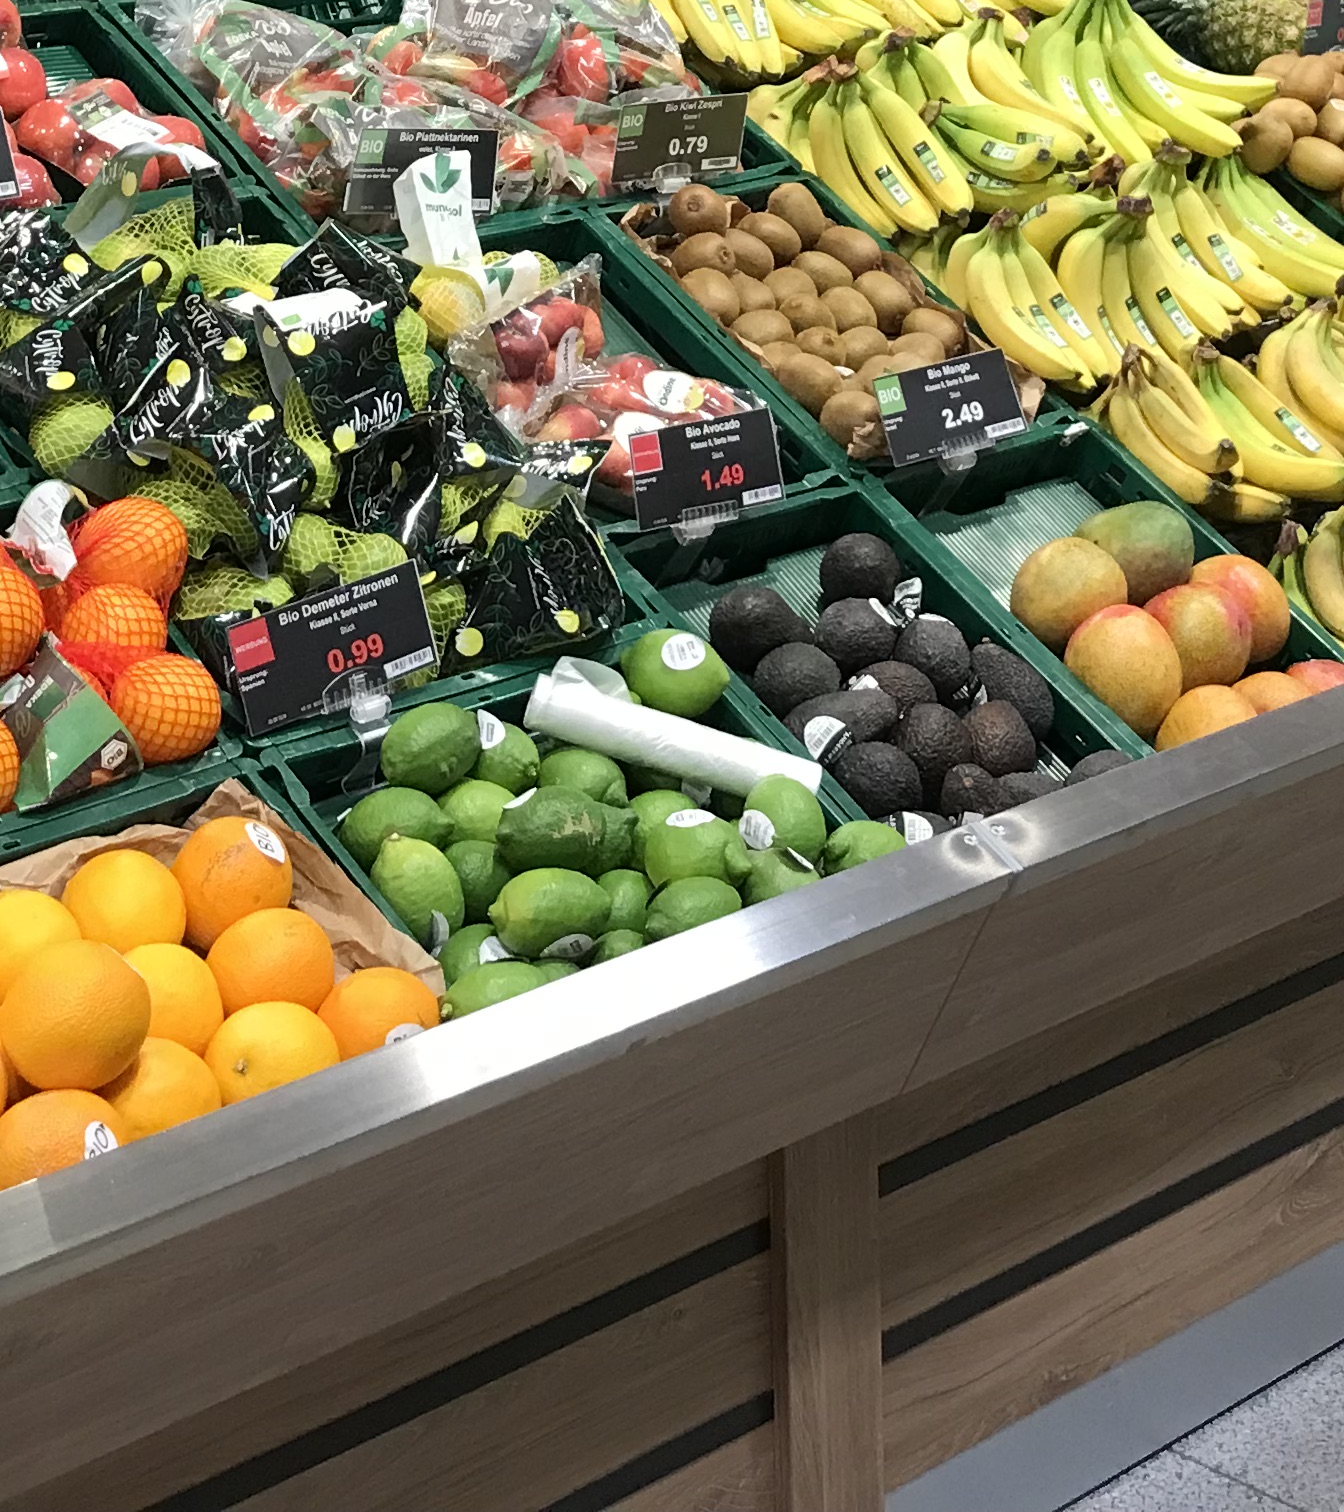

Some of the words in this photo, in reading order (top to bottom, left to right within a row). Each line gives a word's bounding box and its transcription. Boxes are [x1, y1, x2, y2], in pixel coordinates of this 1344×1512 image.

[464, 4, 503, 28] Äpfel
[225, 32, 258, 46] EDEKA
[665, 104, 678, 112] Bio
[680, 102, 696, 111] Kiwi
[698, 99, 722, 110] Zespri
[622, 114, 644, 128] BIO
[360, 140, 383, 153] BIO
[400, 132, 414, 142] Bio
[416, 132, 479, 142] Plattnektarinen
[669, 136, 708, 156] 0.79
[927, 368, 942, 380] Bio
[942, 362, 971, 375] Mango
[660, 376, 677, 407] Ondine
[878, 387, 901, 404] BIO
[941, 401, 984, 429] 2.49
[685, 427, 701, 438] Bio
[703, 419, 740, 435] Avocado
[701, 463, 744, 491] 1.49
[278, 610, 300, 626] Bio
[302, 592, 351, 618] Demeter
[351, 573, 399, 599] Zitronen
[309, 616, 333, 630] Klasse
[341, 606, 358, 619] Sorte
[340, 623, 356, 635] Stück
[327, 633, 384, 673] 0.99
[25, 674, 54, 708] EDEKA
[106, 745, 124, 765] BIO
[256, 823, 275, 853] BIO
